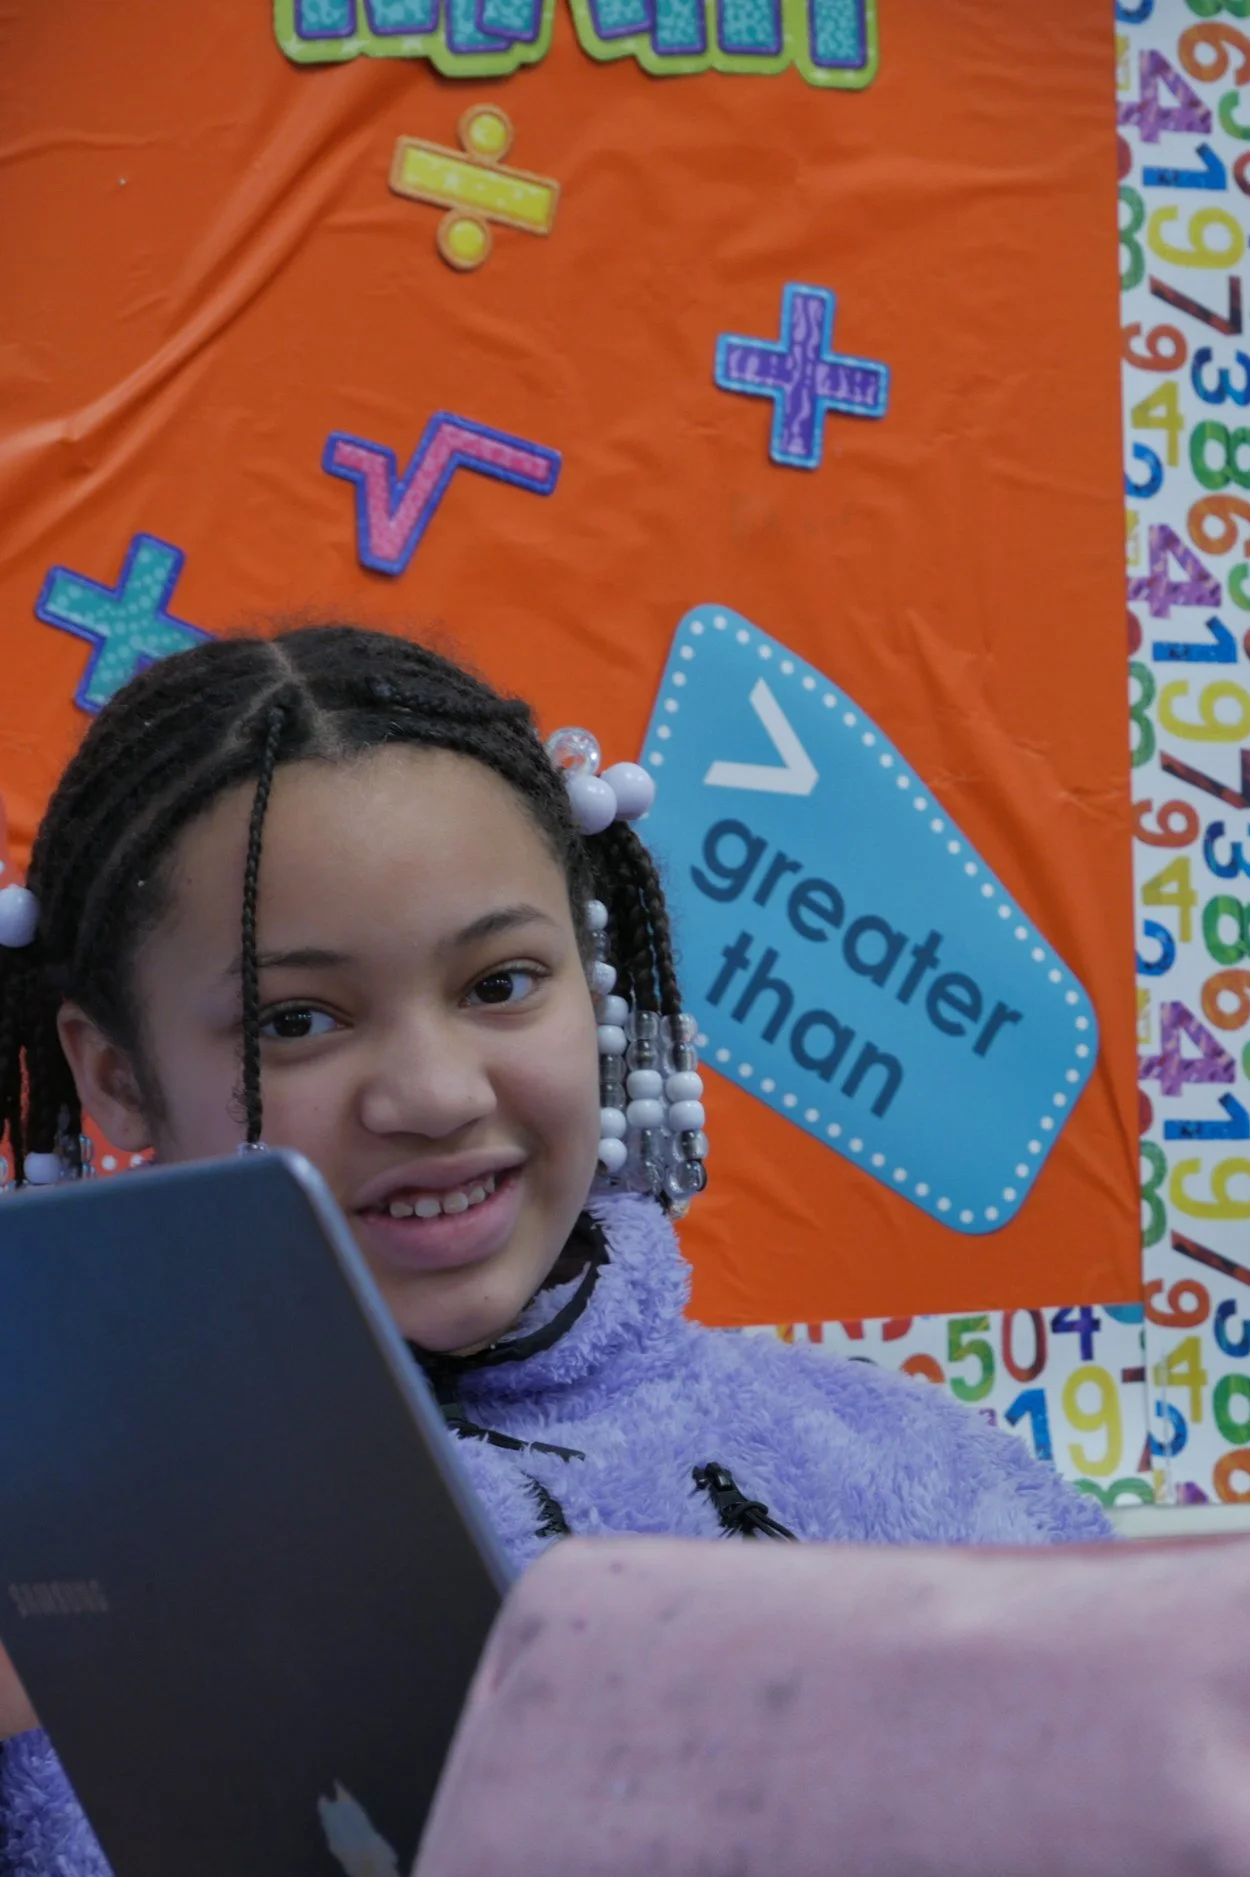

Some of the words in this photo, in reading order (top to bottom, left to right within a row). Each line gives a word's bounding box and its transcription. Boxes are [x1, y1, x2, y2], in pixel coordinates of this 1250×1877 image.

[1117, 48, 1212, 144] 4
[1142, 143, 1227, 191] 1
[1147, 205, 1245, 270] 9
[1149, 273, 1242, 336] 7
[1132, 380, 1184, 468] 4
[1127, 523, 1221, 618] 4
[1153, 615, 1238, 664] 1
[690, 817, 1024, 1058] greater
[1141, 855, 1197, 943] 4
[705, 930, 904, 1118] than
[1138, 1000, 1236, 1097] 4
[947, 1315, 995, 1403] 5
[1002, 1309, 1048, 1383] 0
[1153, 1335, 1208, 1425] 4
[1004, 1387, 1052, 1464] 1
[1062, 1364, 1123, 1478] 9
